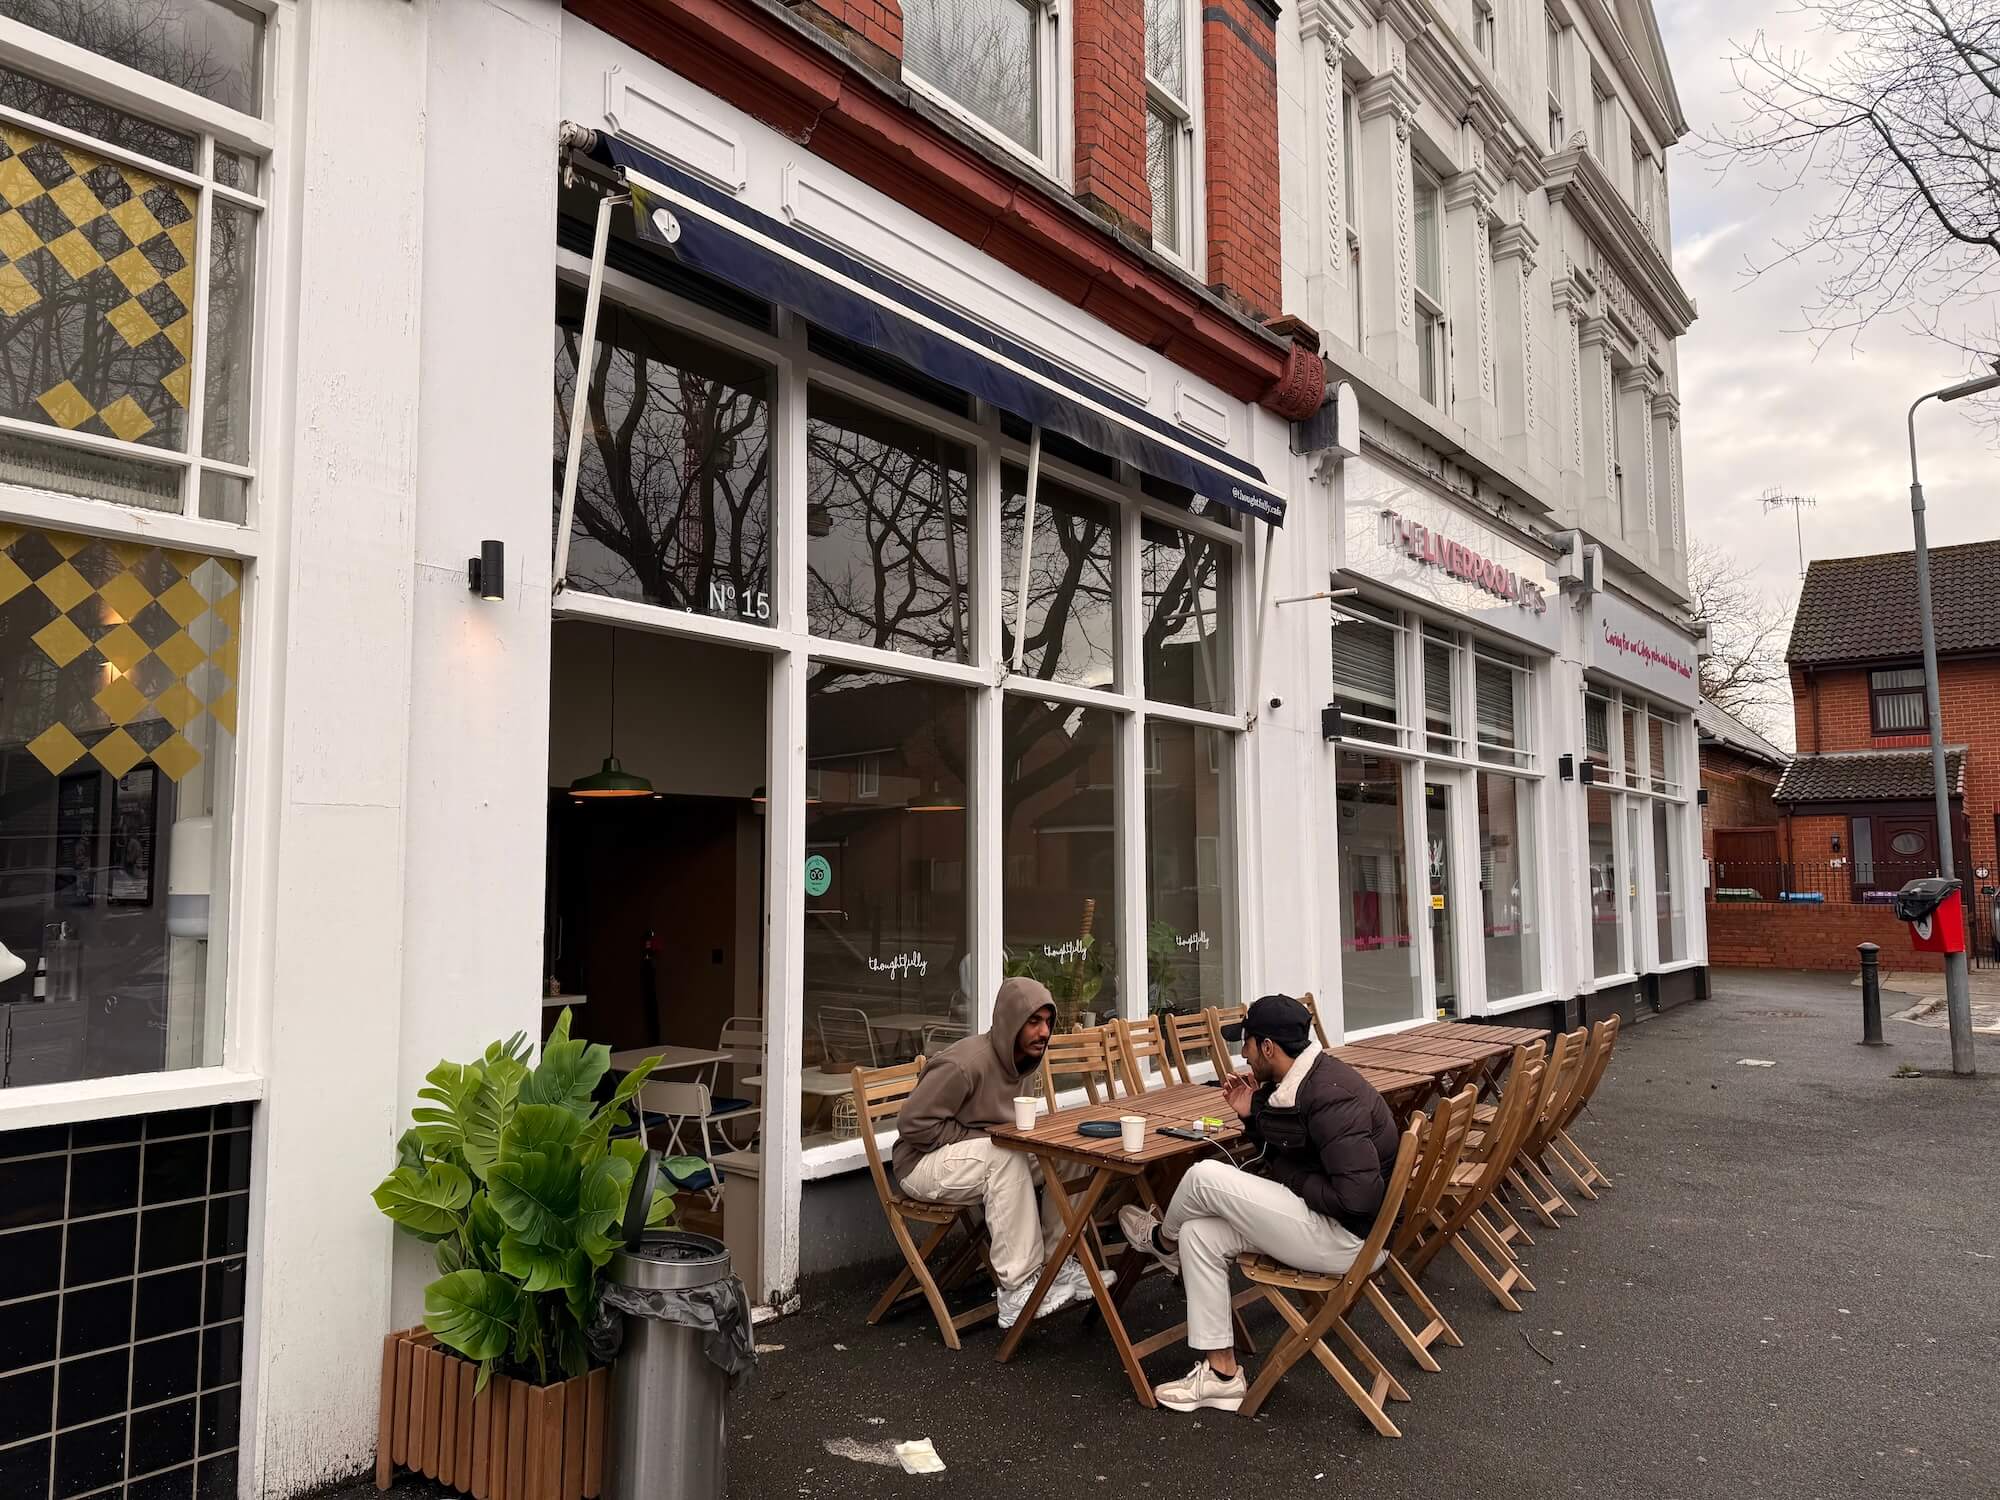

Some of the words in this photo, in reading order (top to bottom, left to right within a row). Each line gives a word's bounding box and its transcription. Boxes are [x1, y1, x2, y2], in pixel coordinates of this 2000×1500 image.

[1423, 527, 1517, 602] LIVERPOOL
[742, 589, 770, 619] 15
[1043, 938, 1088, 965] thoughtfully
[1174, 930, 1209, 953] thoughtfully
[868, 950, 928, 981] thoughtfully
